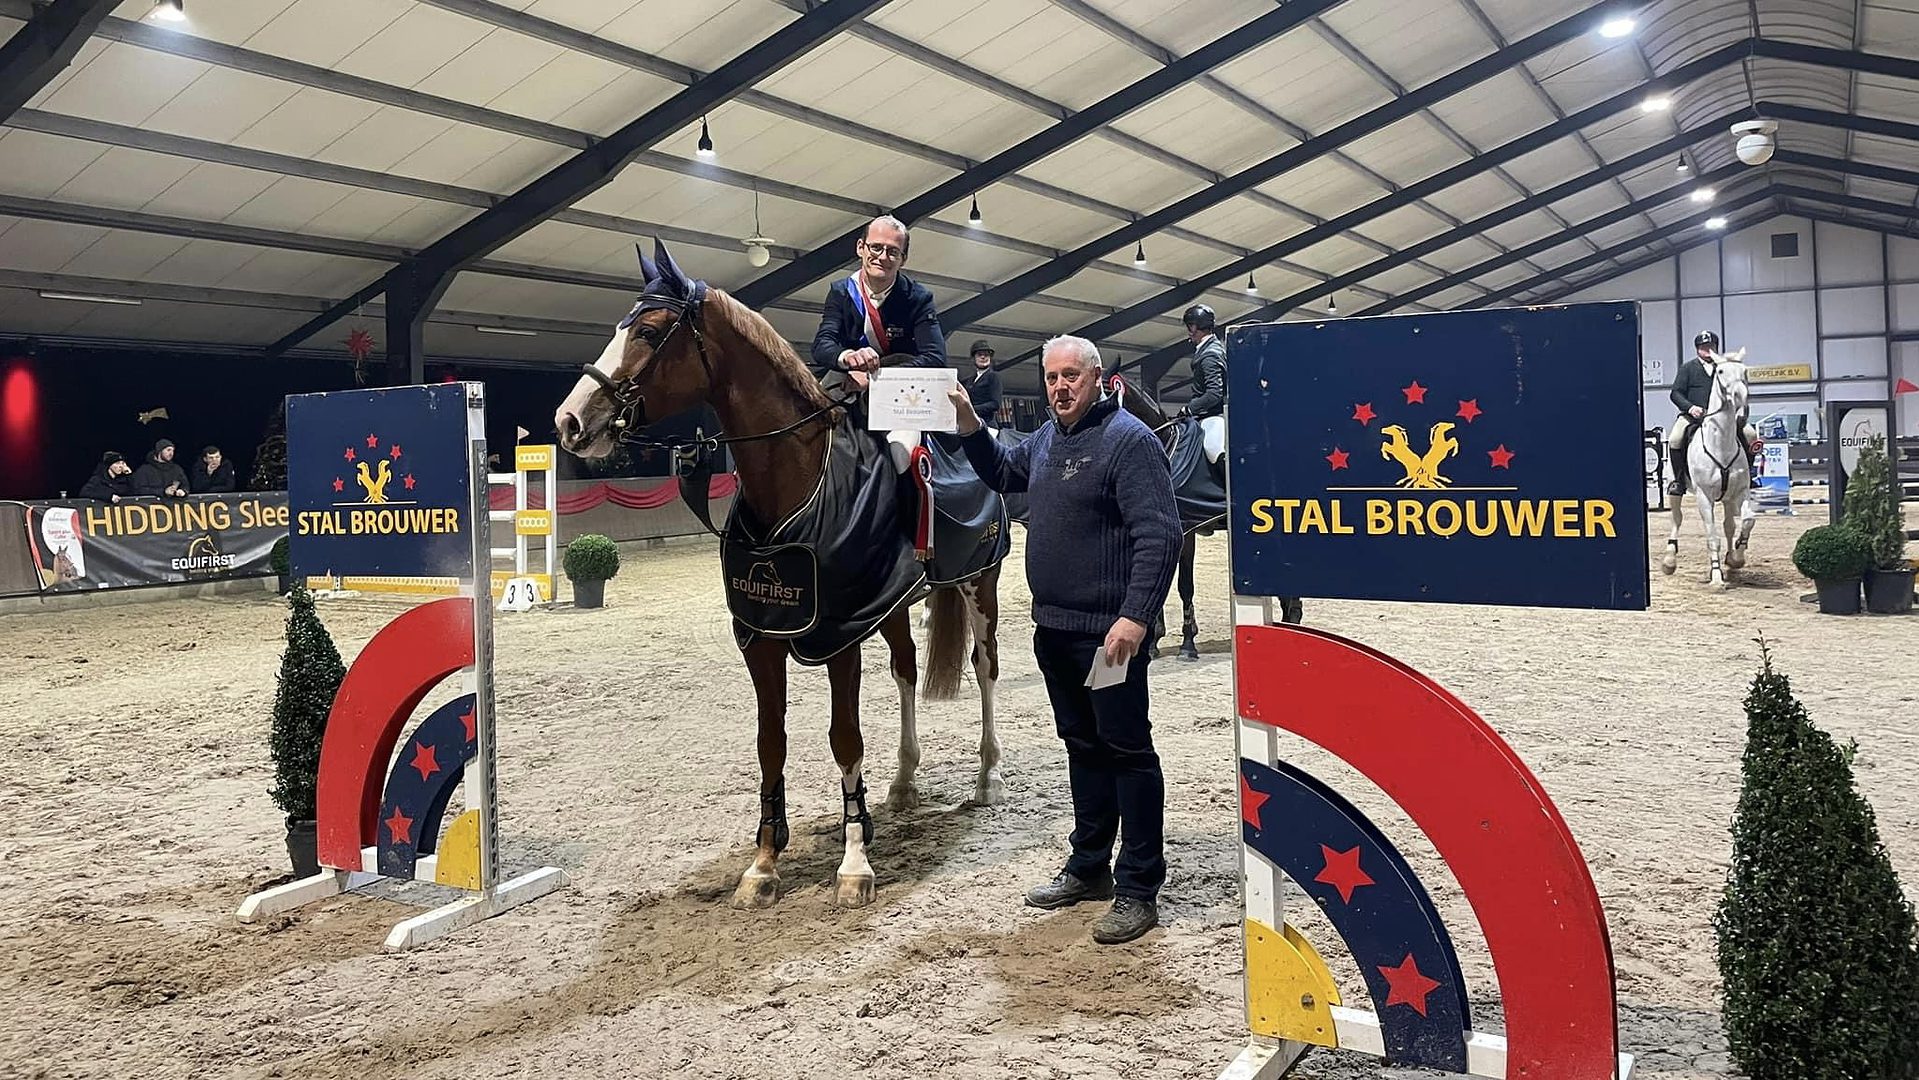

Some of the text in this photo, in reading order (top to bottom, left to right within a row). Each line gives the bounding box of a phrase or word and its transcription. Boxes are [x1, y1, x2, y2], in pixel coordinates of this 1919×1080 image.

[86, 499, 290, 537] HIDDING Slee
[297, 508, 459, 535] STAL BROUWER
[1250, 498, 1617, 538] STAL BROUWER
[171, 553, 236, 570] EQUIFIRST
[508, 584, 516, 604] 3
[526, 583, 534, 602] 3
[732, 577, 804, 600] EQUIFIRST
